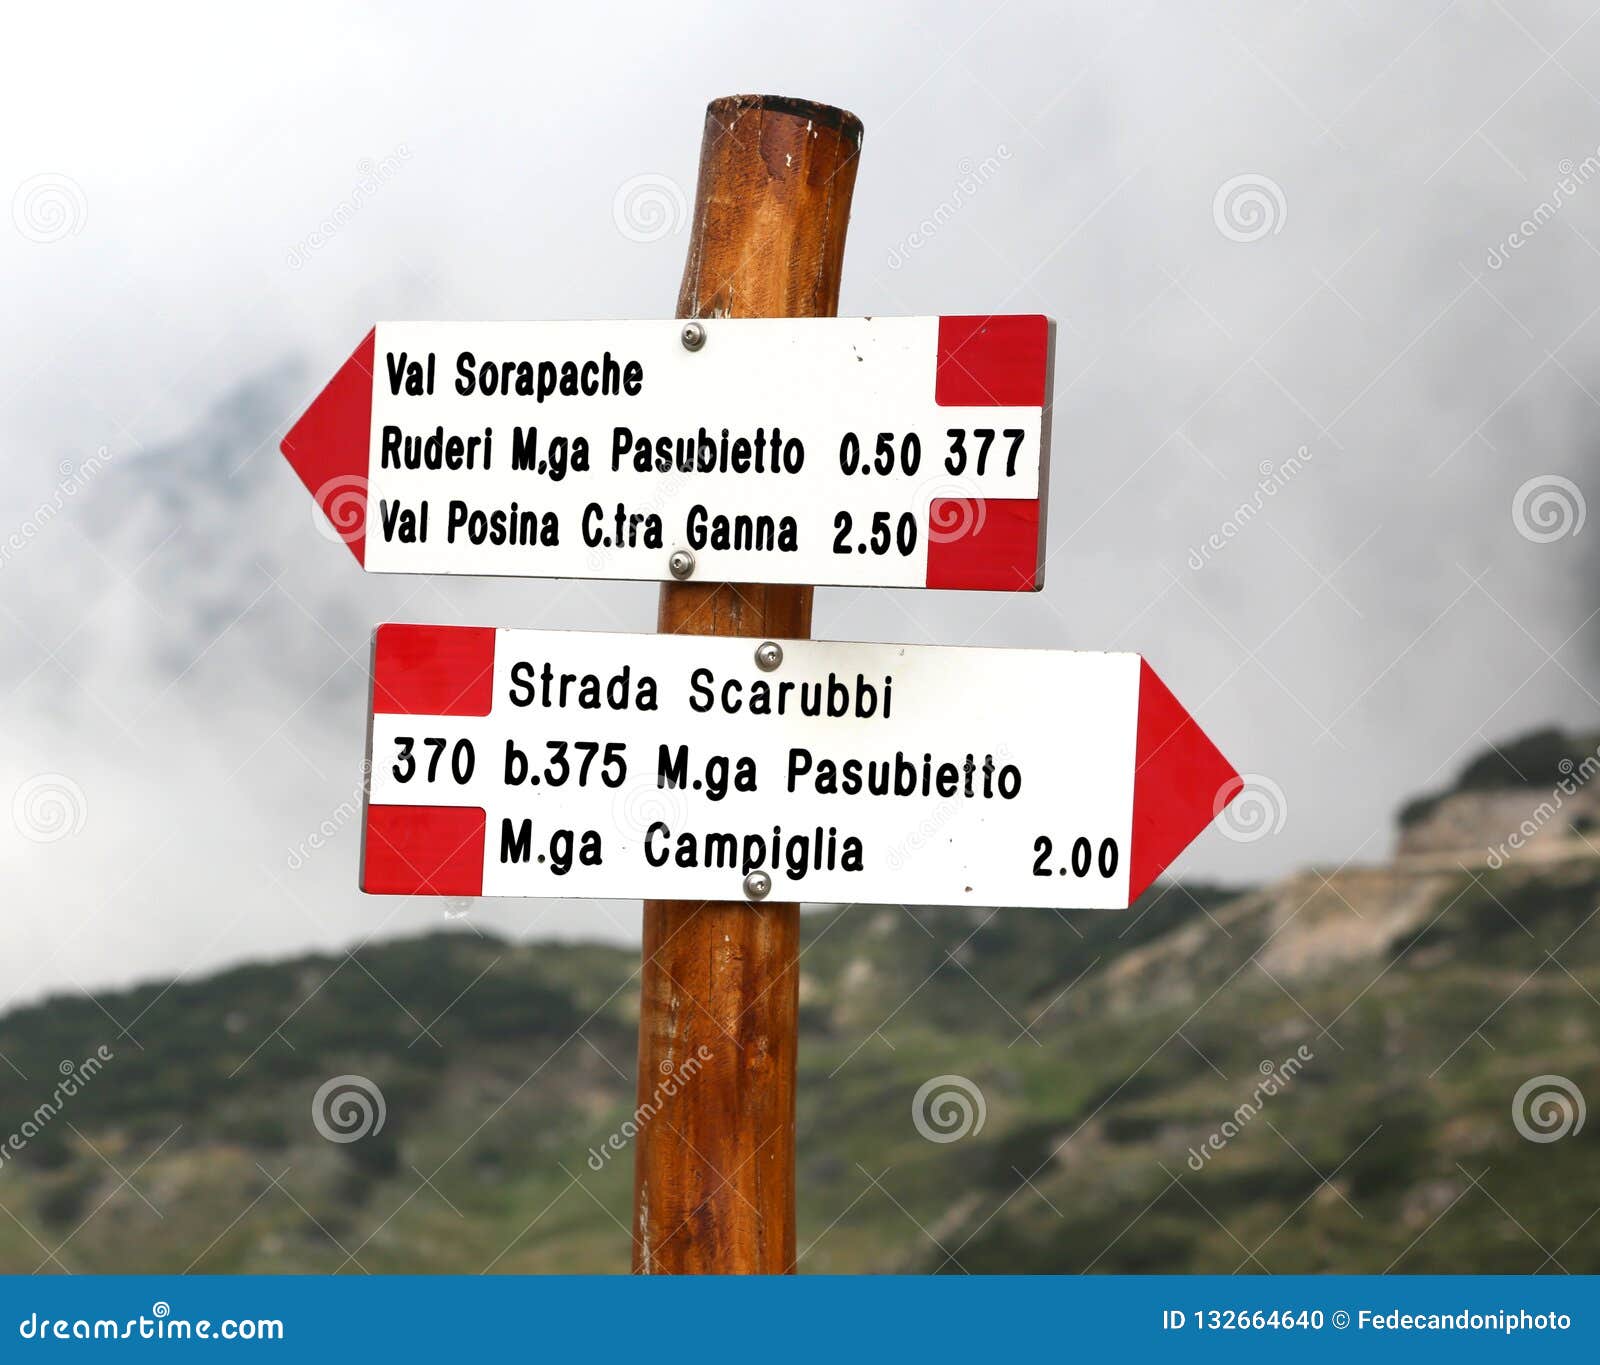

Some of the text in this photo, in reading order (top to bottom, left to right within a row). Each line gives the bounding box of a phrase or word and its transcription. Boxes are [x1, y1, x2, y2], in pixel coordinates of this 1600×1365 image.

[386, 351, 644, 404] Val Sorapache
[380, 425, 493, 471] Ruderi
[611, 426, 805, 475] Pasubietto
[838, 431, 922, 477] 0.50
[943, 428, 1025, 478] 377
[379, 499, 918, 557] Val Posina C.tra Ganna 2.50
[508, 661, 893, 719] Strada Scarubbi
[391, 736, 1022, 801] 370 b.375 M.ga Pasubietto
[499, 817, 1119, 881] M.ga Campiglia 2.00
